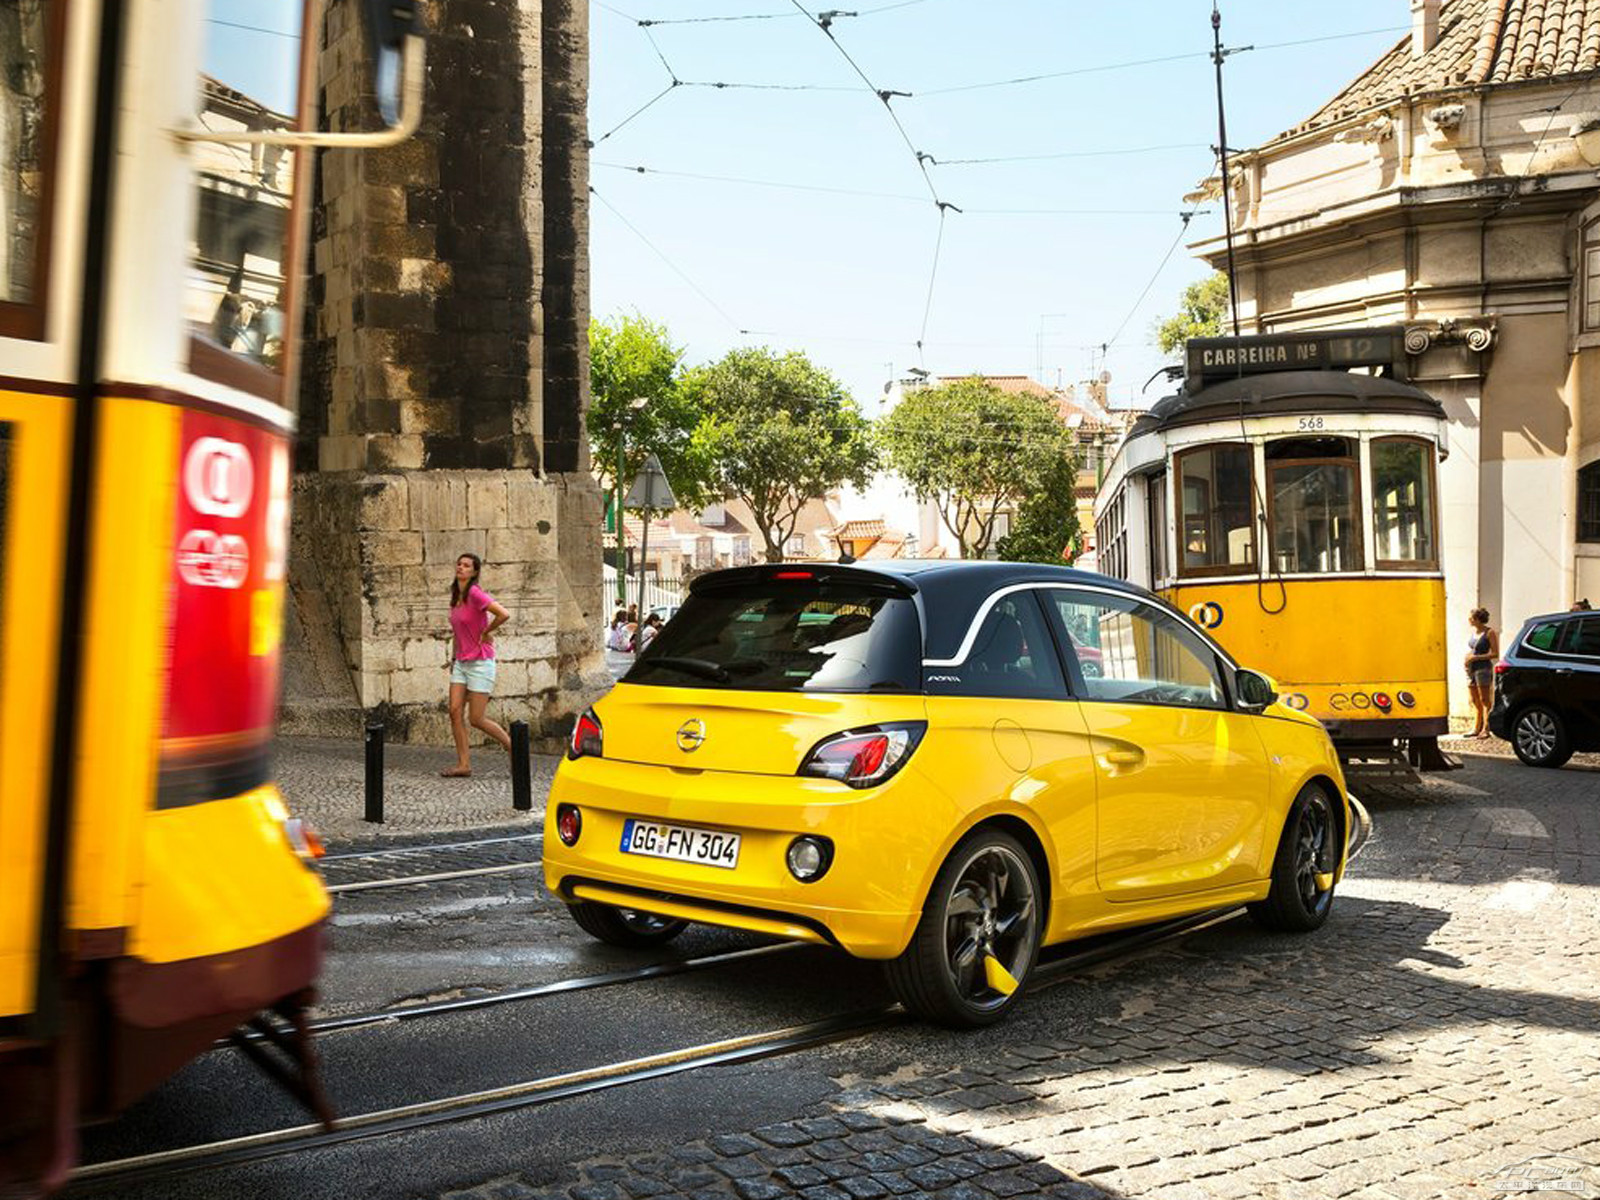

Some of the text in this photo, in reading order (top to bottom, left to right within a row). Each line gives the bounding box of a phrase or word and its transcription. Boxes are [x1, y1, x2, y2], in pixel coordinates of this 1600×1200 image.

[1203, 345, 1287, 366] CARREIRA
[1299, 416, 1323, 429] 568
[632, 825, 736, 863] GG FN 304
